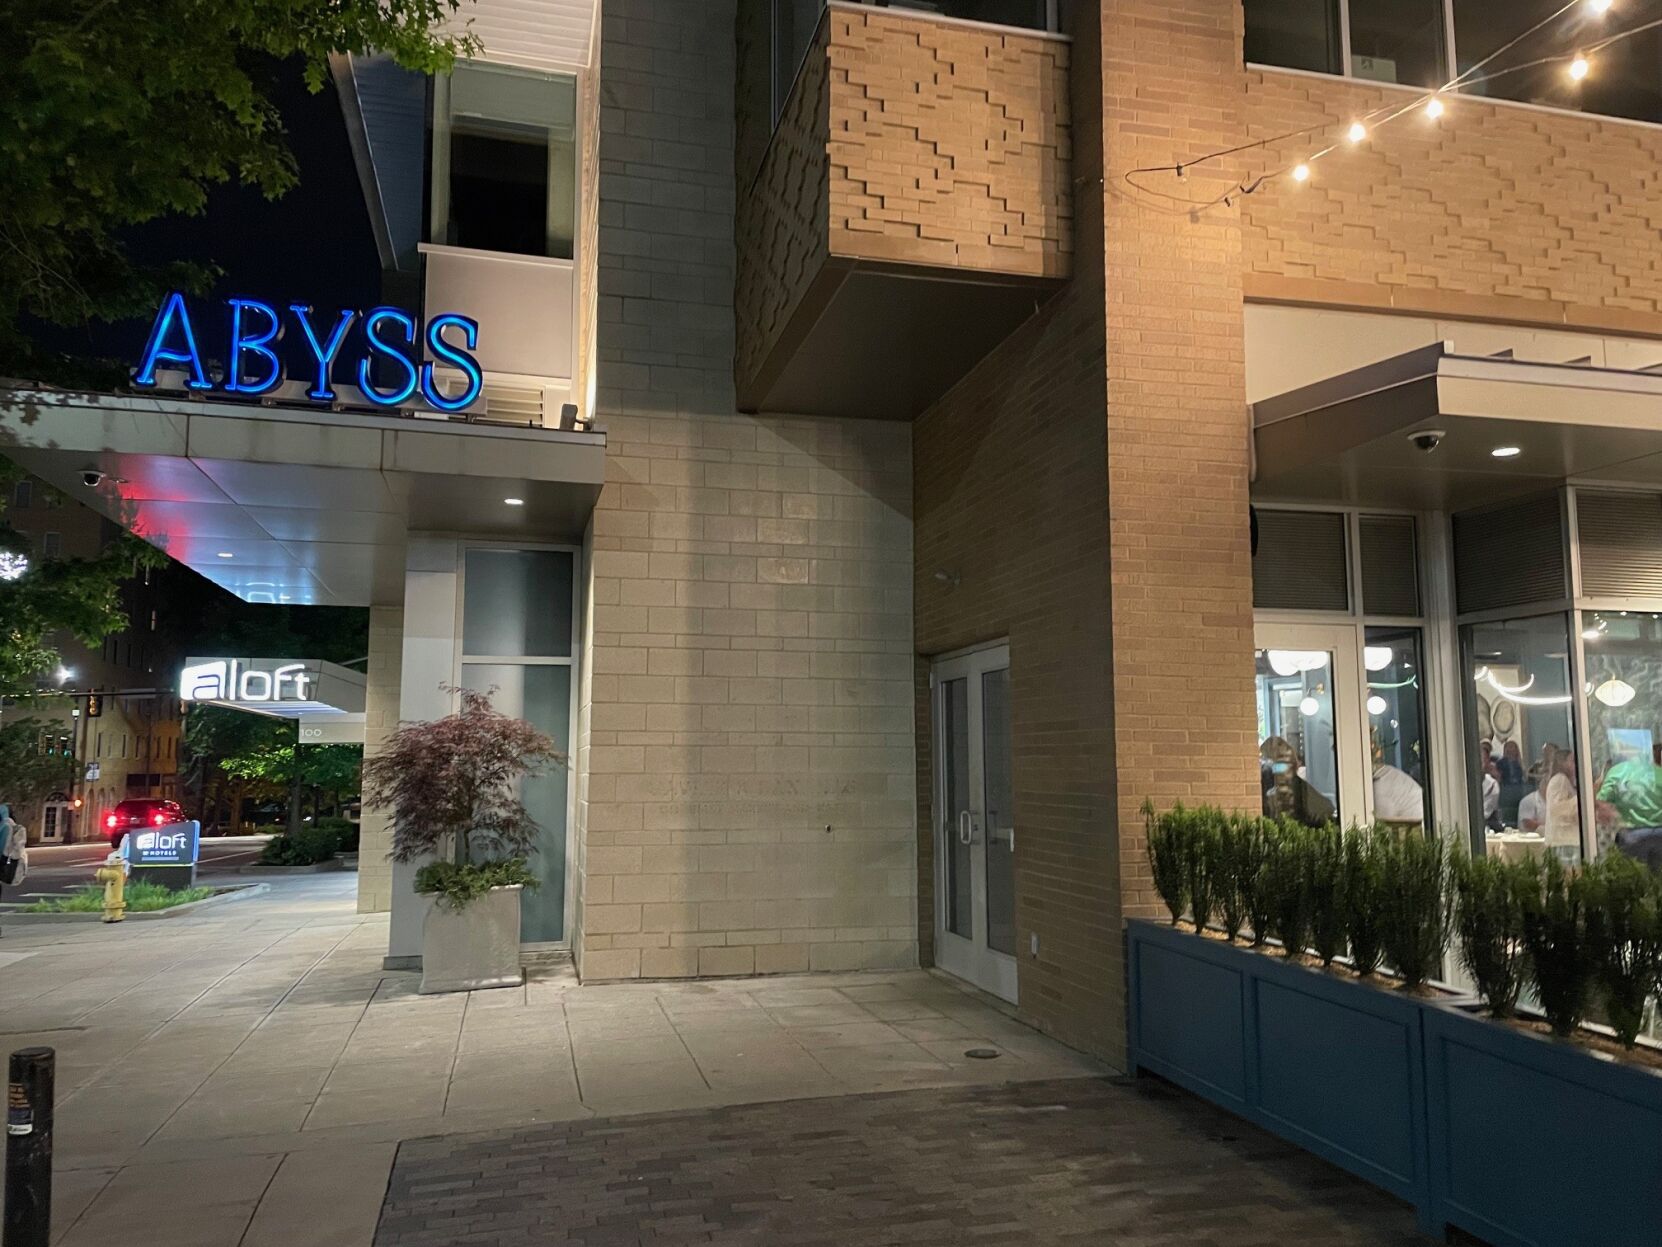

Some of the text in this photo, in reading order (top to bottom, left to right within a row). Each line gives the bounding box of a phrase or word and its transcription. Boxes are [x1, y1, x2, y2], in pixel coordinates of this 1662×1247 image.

[134, 292, 484, 411] ABYSS
[180, 659, 310, 701] aloft
[301, 728, 322, 737] 100
[136, 831, 187, 850] aloft
